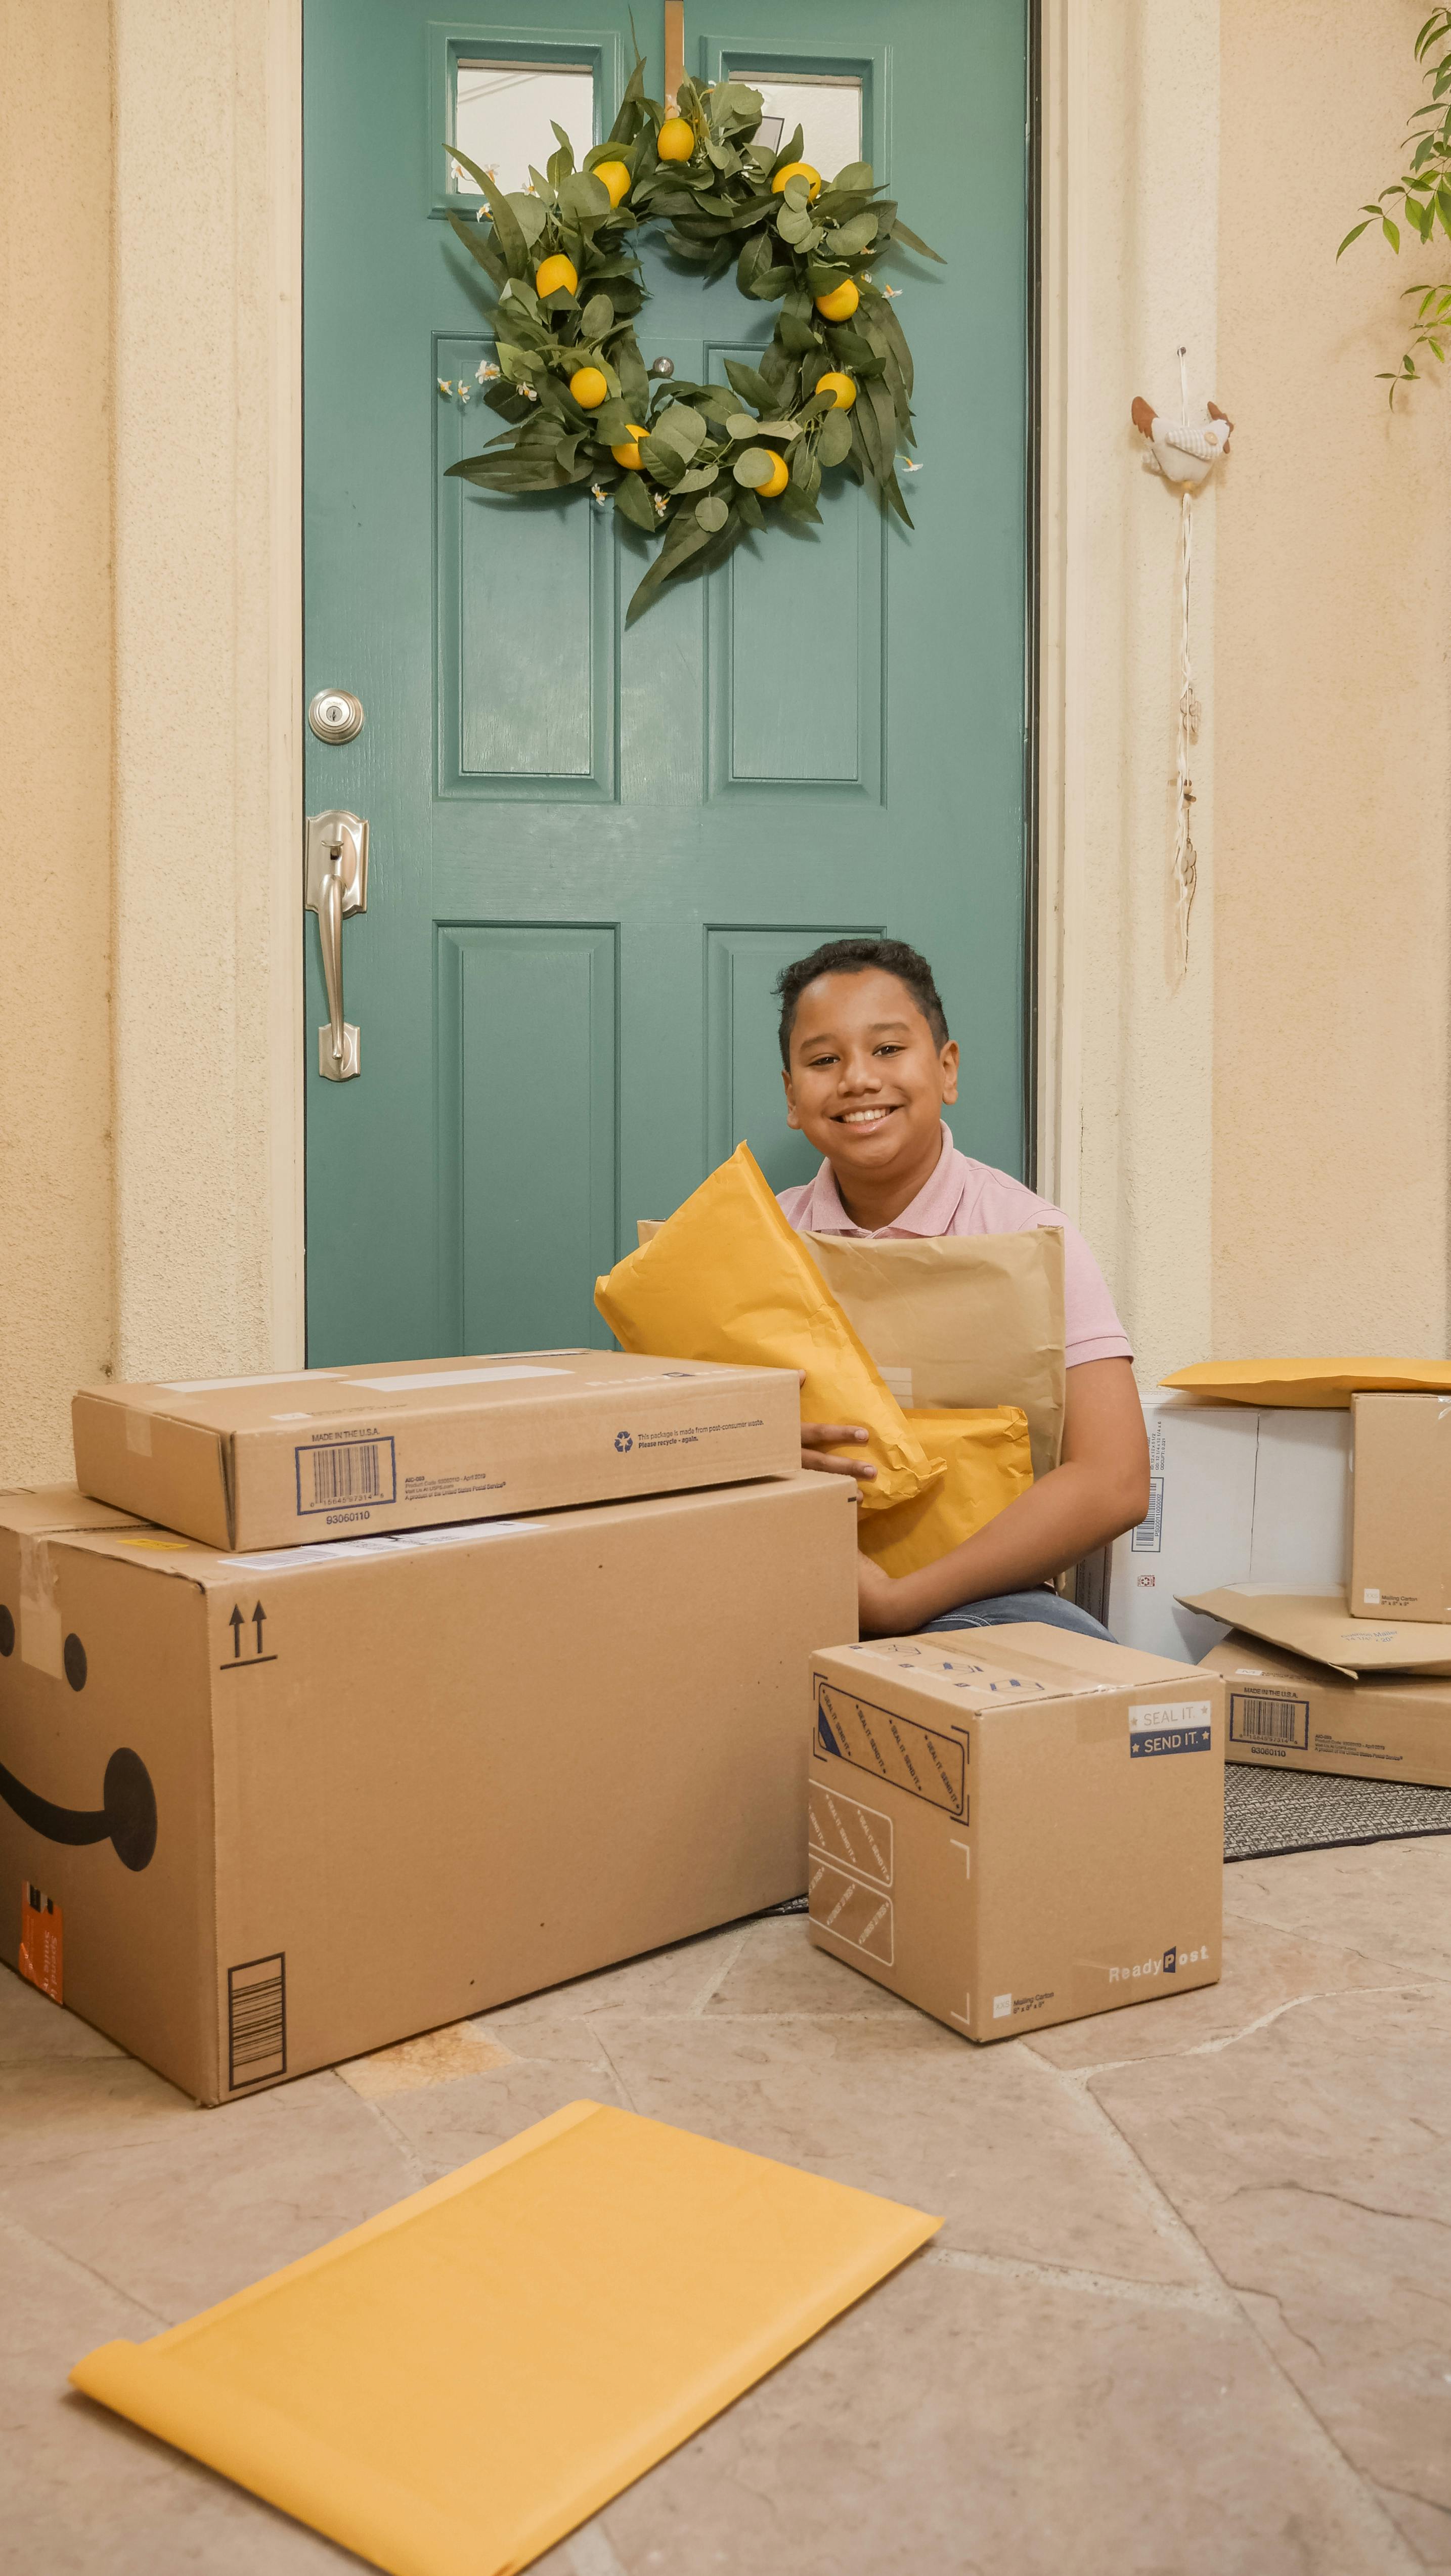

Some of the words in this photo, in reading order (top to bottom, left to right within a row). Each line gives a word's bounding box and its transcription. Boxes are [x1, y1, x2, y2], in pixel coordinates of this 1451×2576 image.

[312, 1432, 333, 1442] MADE
[343, 1429, 358, 1438] THE
[360, 1428, 380, 1436] U.S.A.
[650, 1431, 673, 1440] package
[679, 1428, 694, 1436] made
[709, 1421, 747, 1433] post-consumer
[657, 1438, 677, 1447] recycle
[682, 1435, 698, 1444] again.
[326, 1510, 370, 1524] 93060110
[1144, 1710, 1178, 1726] SEAL
[1182, 1706, 1196, 1720] IT.
[1144, 1734, 1181, 1753] SEND
[1185, 1731, 1198, 1745] IT.
[1251, 1747, 1286, 1757] 93060110
[1109, 1945, 1209, 1983] ReadyPost
